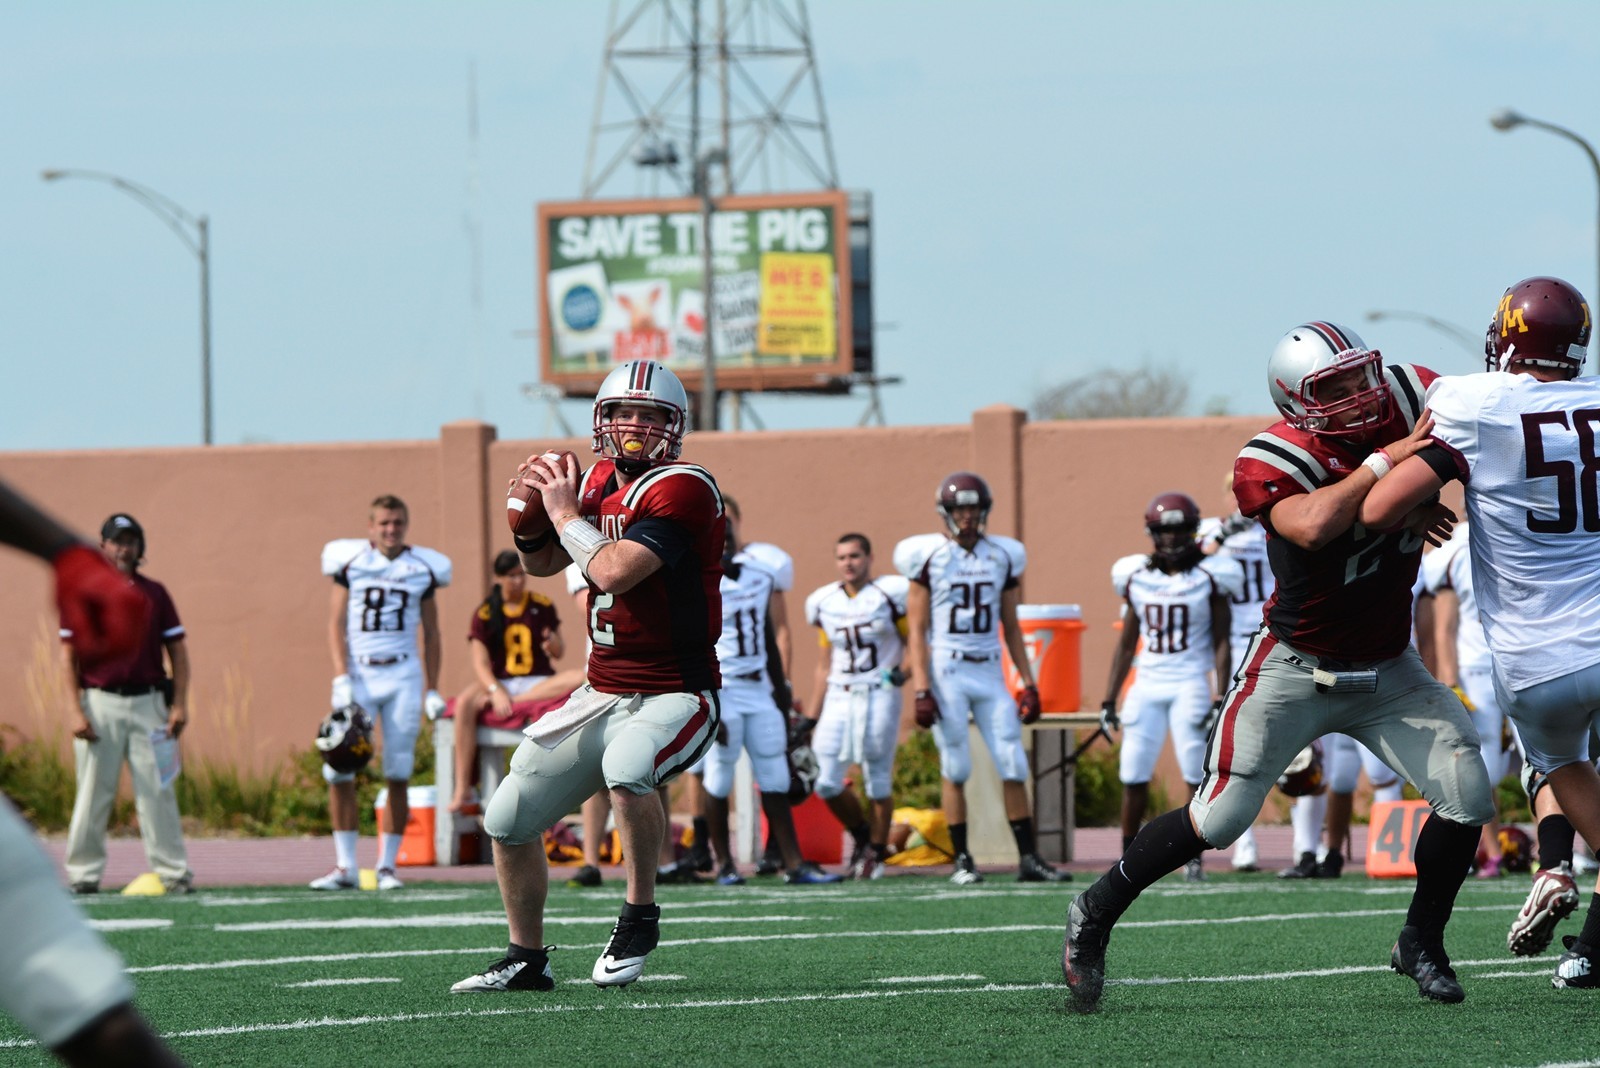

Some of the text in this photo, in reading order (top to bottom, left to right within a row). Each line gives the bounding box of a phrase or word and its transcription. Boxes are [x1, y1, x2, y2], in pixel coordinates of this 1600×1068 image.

[557, 213, 662, 259] SAVE
[757, 207, 829, 251] PIG
[734, 606, 760, 657] 11
[948, 581, 994, 634] 26
[504, 622, 534, 676] 8
